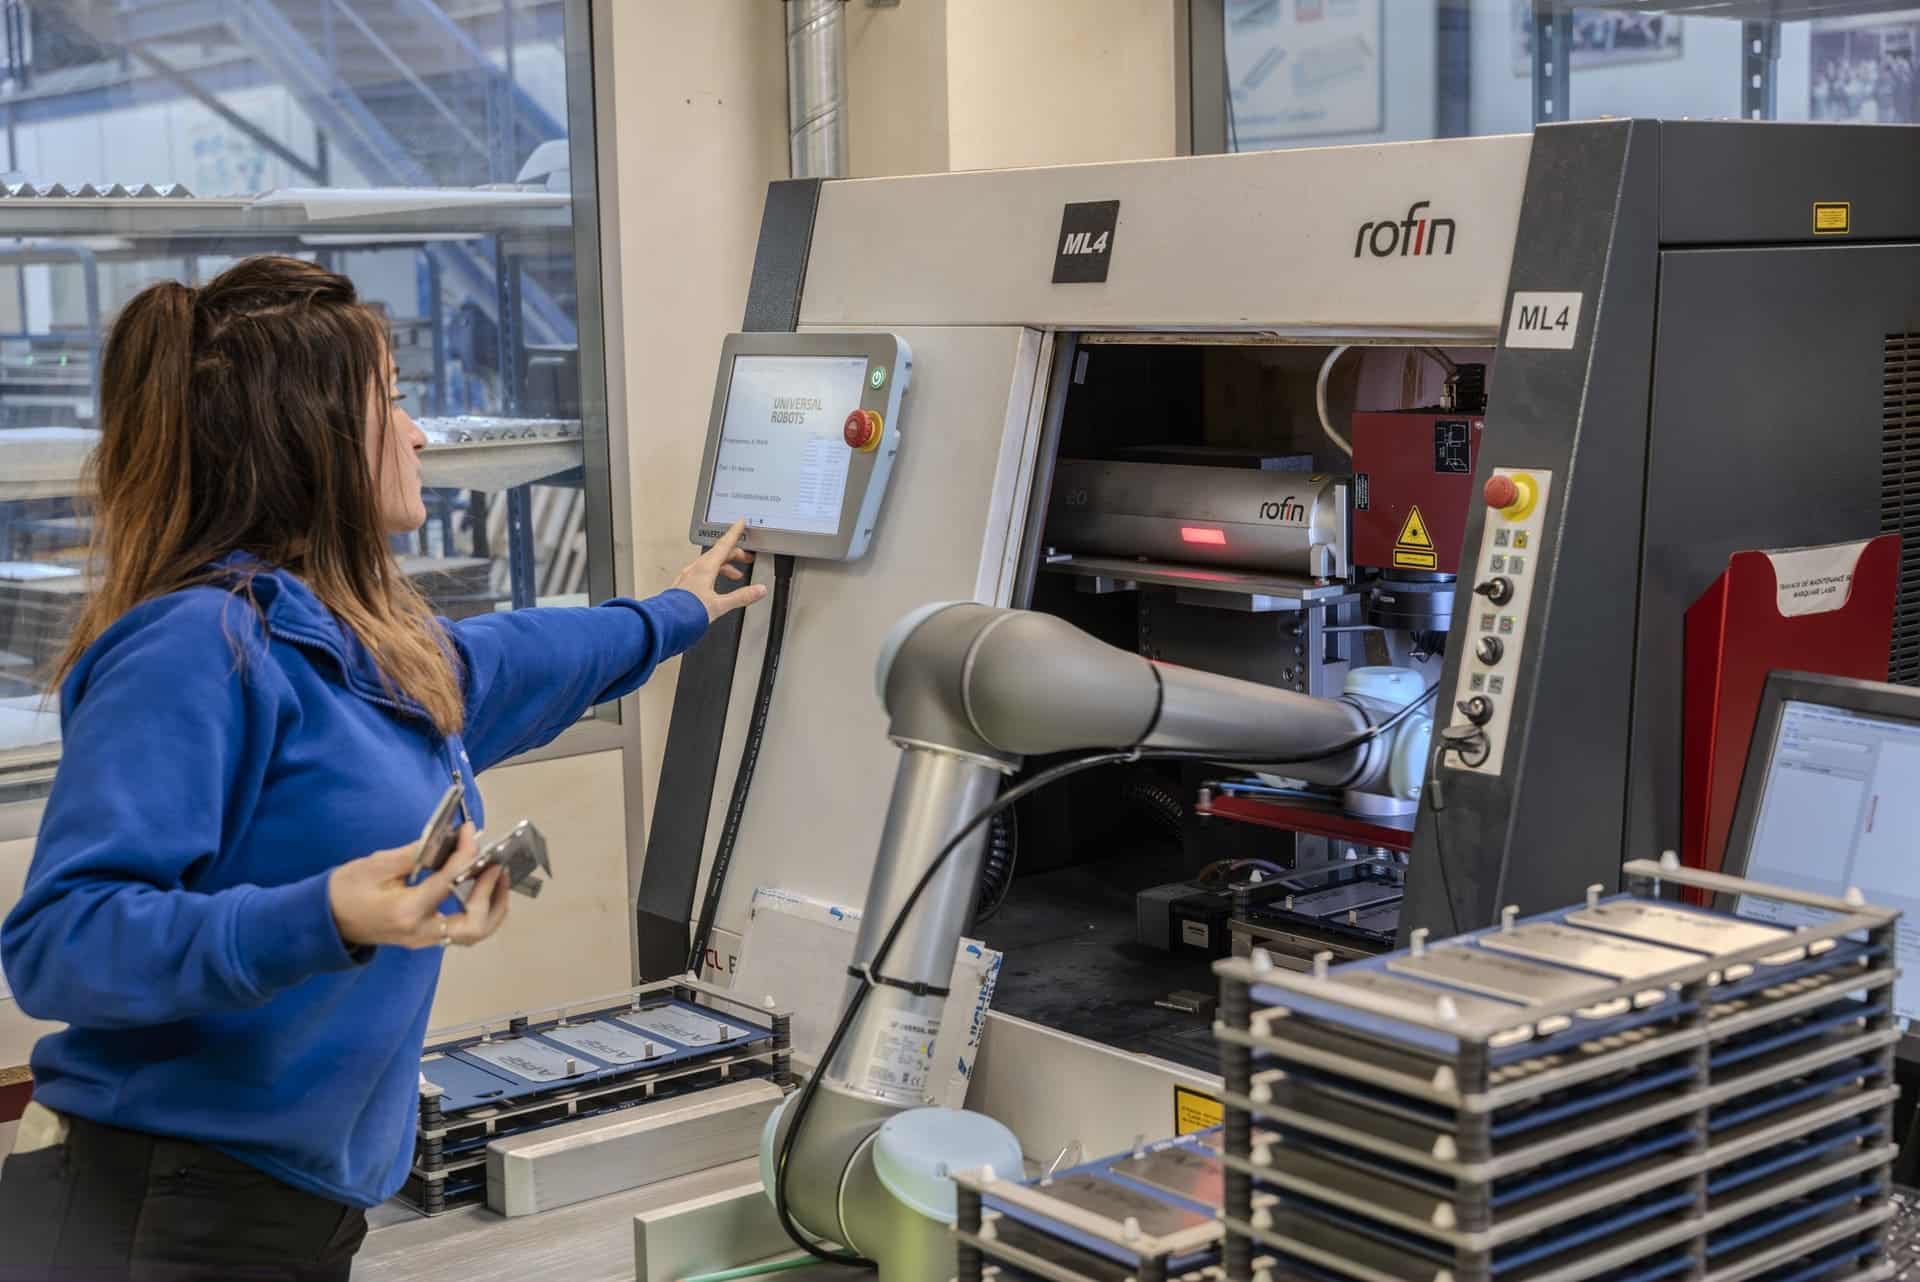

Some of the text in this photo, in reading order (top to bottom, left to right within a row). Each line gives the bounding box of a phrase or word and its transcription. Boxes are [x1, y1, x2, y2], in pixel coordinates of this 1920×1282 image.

[1354, 200, 1456, 258] rofin
[1062, 231, 1109, 255] ML4
[1518, 305, 1570, 331] ML4
[773, 397, 823, 410] UNIVERSAL
[770, 411, 805, 424] ROBOTS
[1259, 496, 1305, 522] rofin
